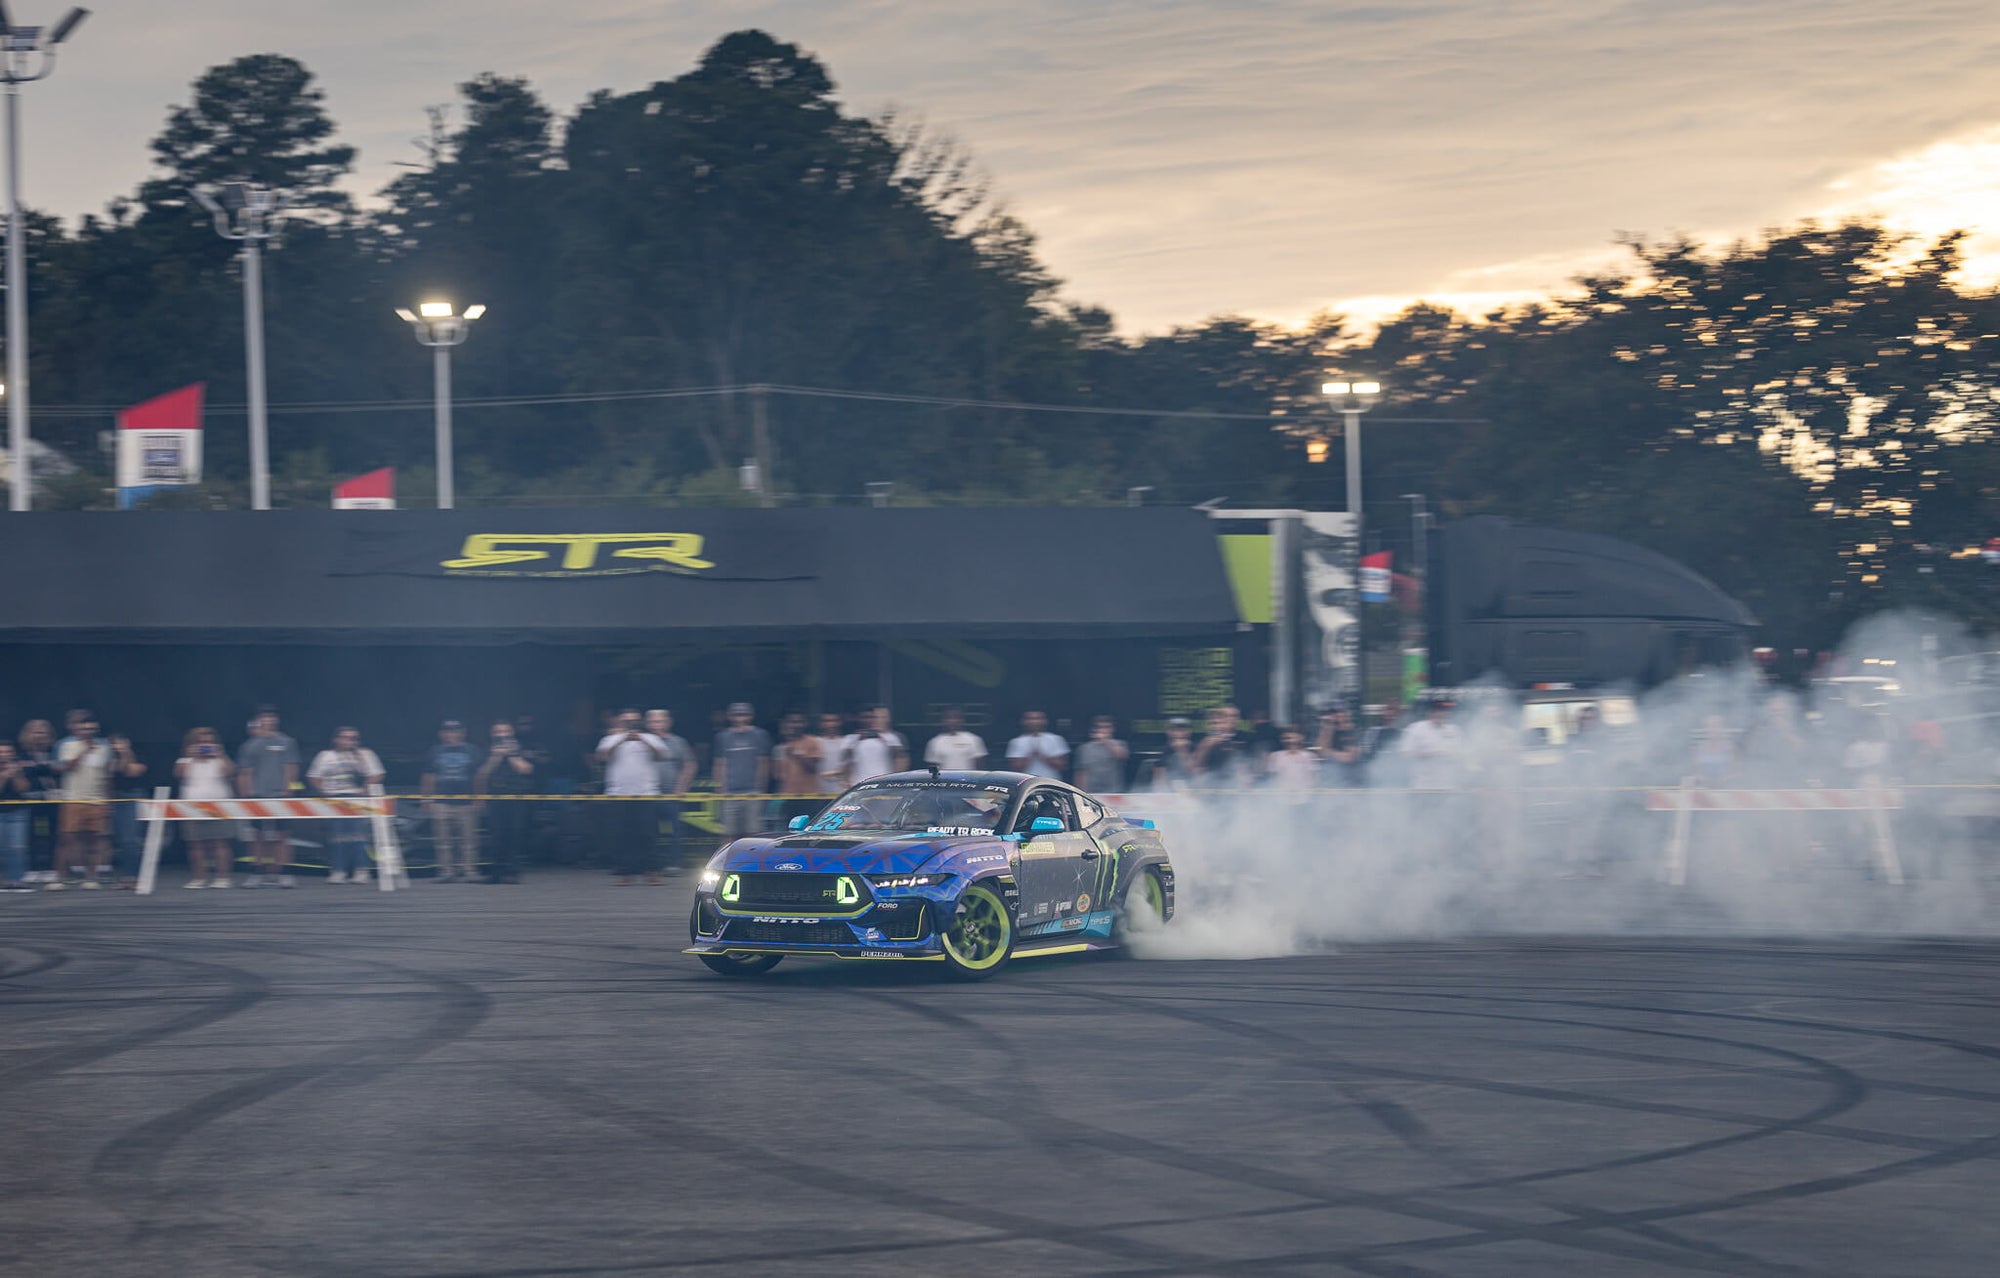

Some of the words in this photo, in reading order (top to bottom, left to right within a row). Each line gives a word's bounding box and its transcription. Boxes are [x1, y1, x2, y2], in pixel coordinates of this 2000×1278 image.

[810, 812, 853, 831] 25
[927, 826, 955, 836] READY
[957, 827, 969, 836] TO
[970, 827, 995, 837] ROCK
[966, 854, 1004, 864] NITTO
[753, 916, 820, 924] NITTO
